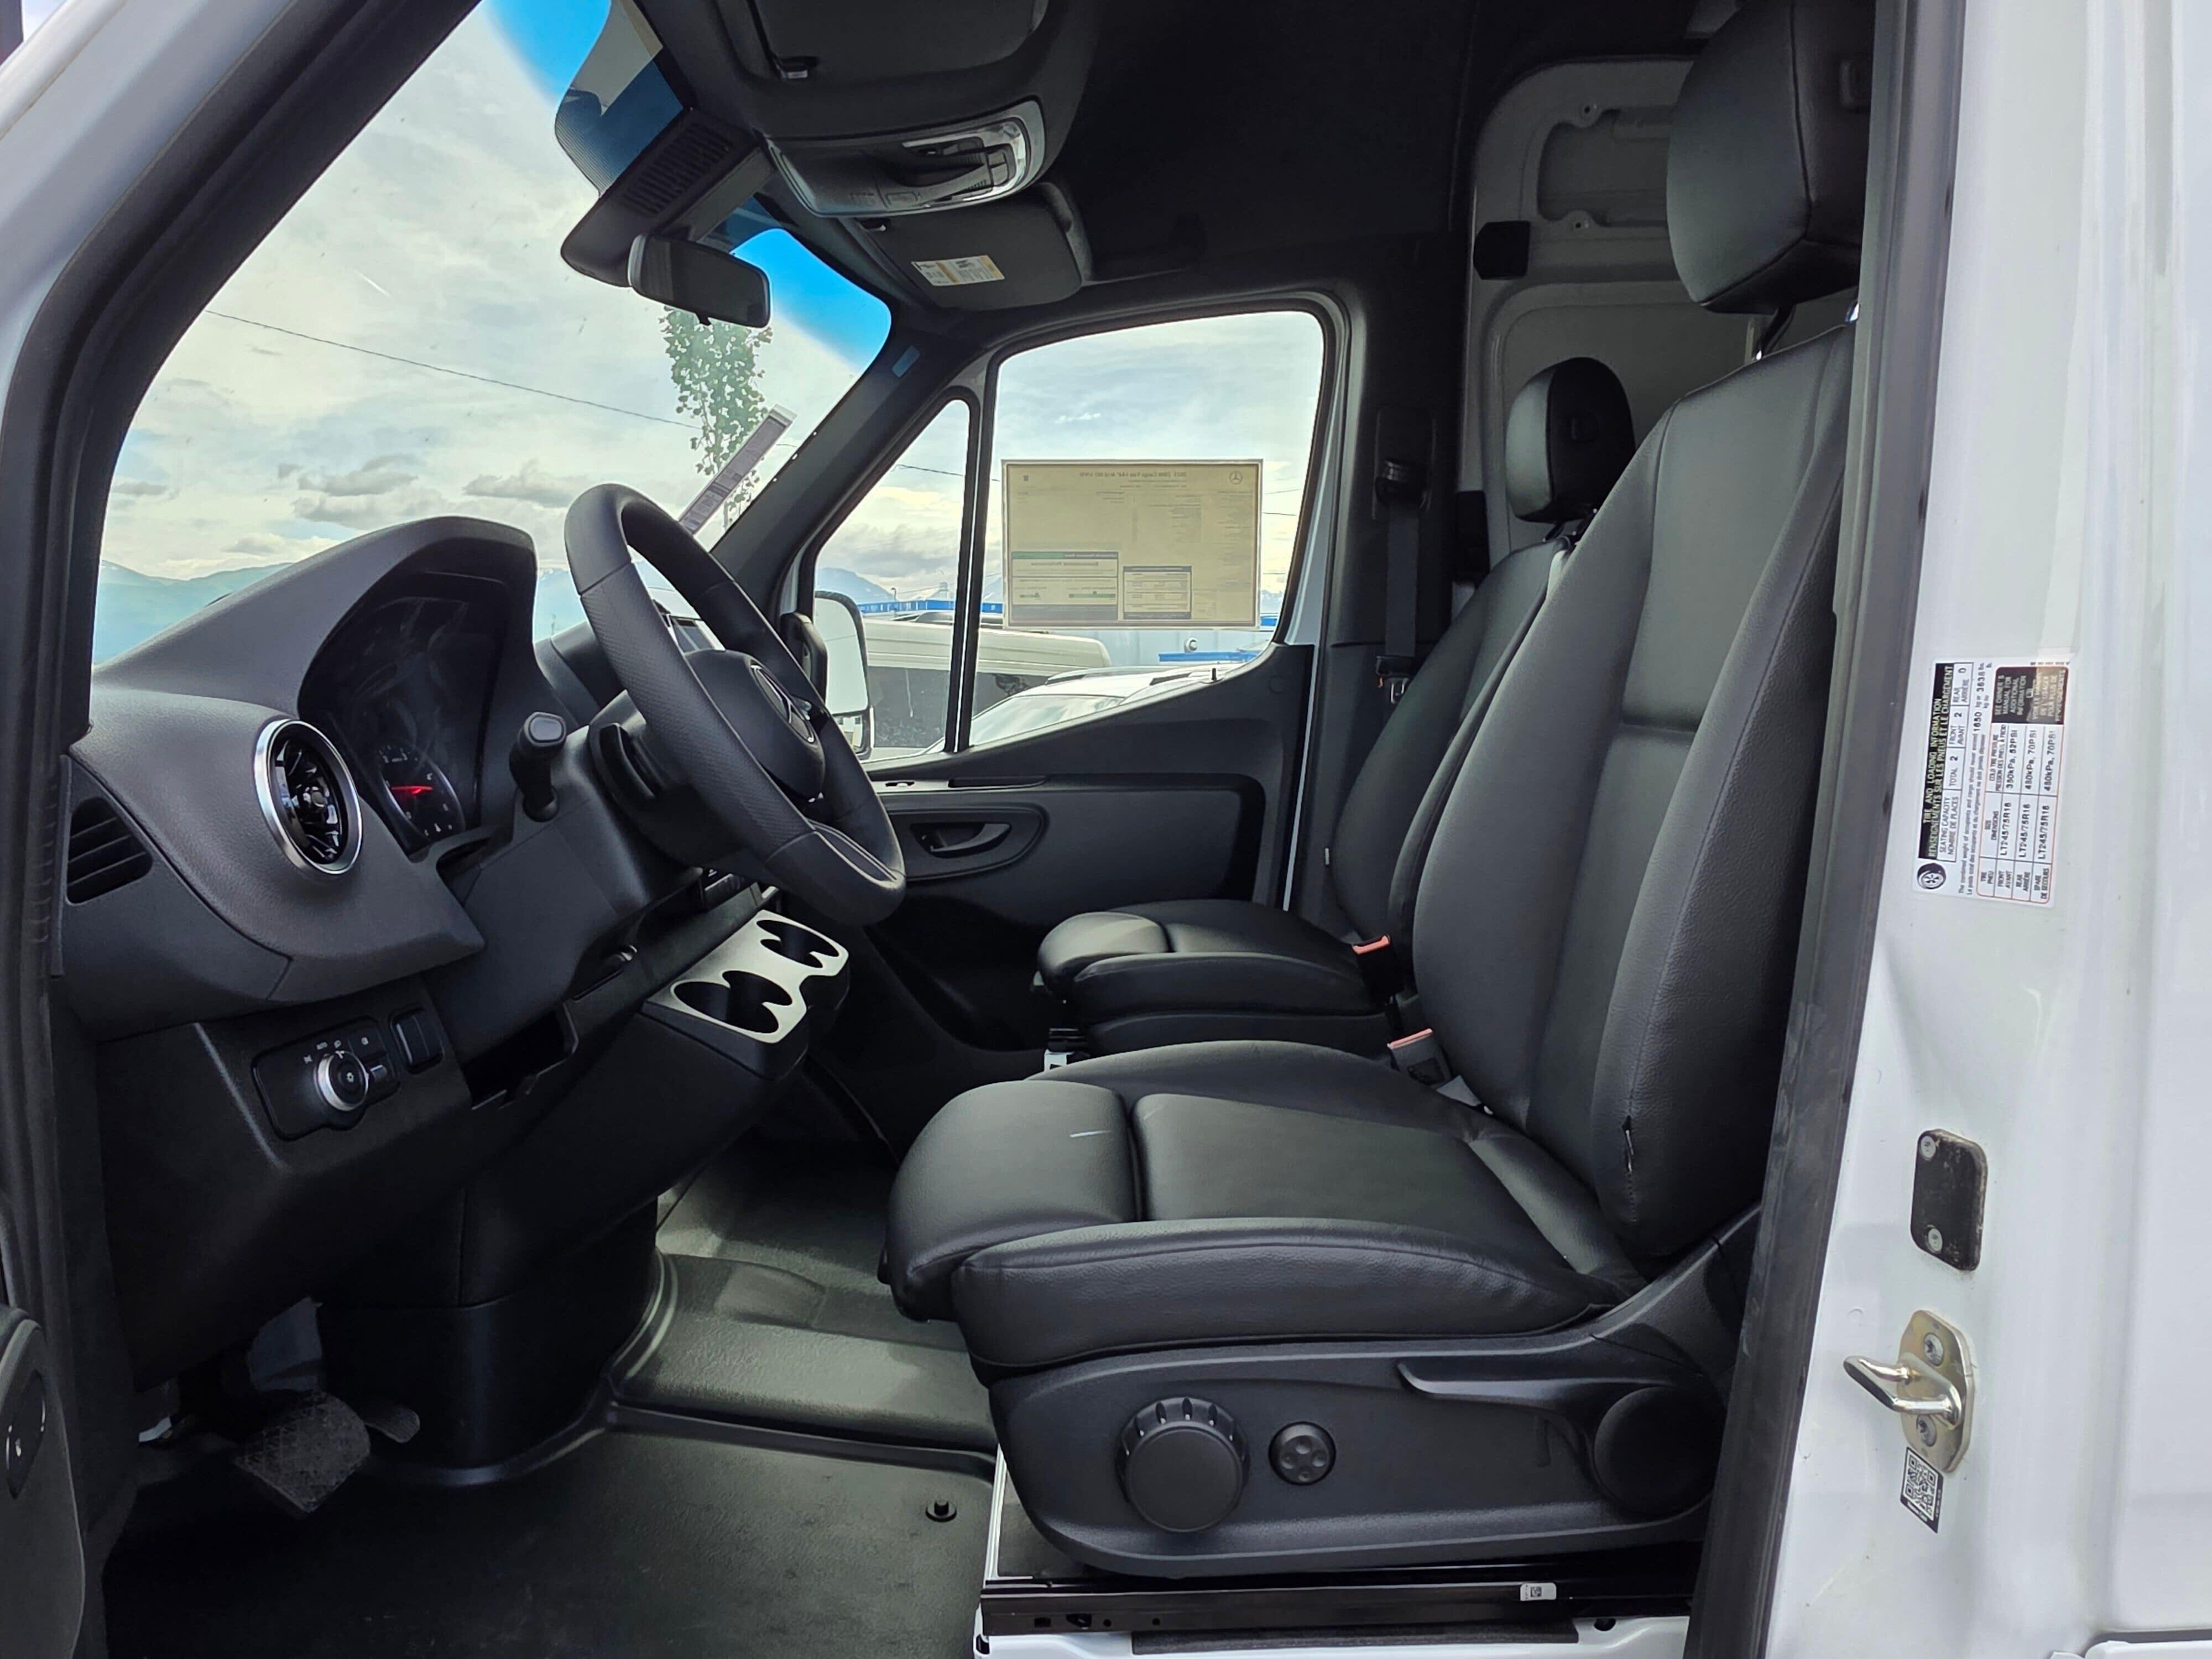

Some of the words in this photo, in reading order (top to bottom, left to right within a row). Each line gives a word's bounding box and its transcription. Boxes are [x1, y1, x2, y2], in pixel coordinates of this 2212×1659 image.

[1940, 666, 1953, 713] CHARGEMENT
[1929, 698, 1942, 747] INFORMATION
[1939, 727, 1947, 735] ET
[1940, 716, 1948, 725] LE
[1948, 725, 1957, 744] FRONT
[1957, 725, 1965, 744] AVANT
[1937, 738, 1946, 761] PNEUS
[1927, 751, 1937, 784] LOADING
[1936, 763, 1944, 776] LES
[1949, 767, 1957, 786] TOTAL
[1924, 787, 1934, 804] AND
[1934, 779, 1942, 792] SUR
[1923, 808, 1932, 823] TIRE
[1941, 797, 1950, 826] CAPACITY
[1950, 796, 1958, 819] PLACES
[1939, 827, 1948, 852] SEATING
[1999, 802, 2011, 855] LT245/75R16
[2018, 803, 2030, 858] LT245/75R16
[2037, 804, 2050, 859] LT245/75R16
